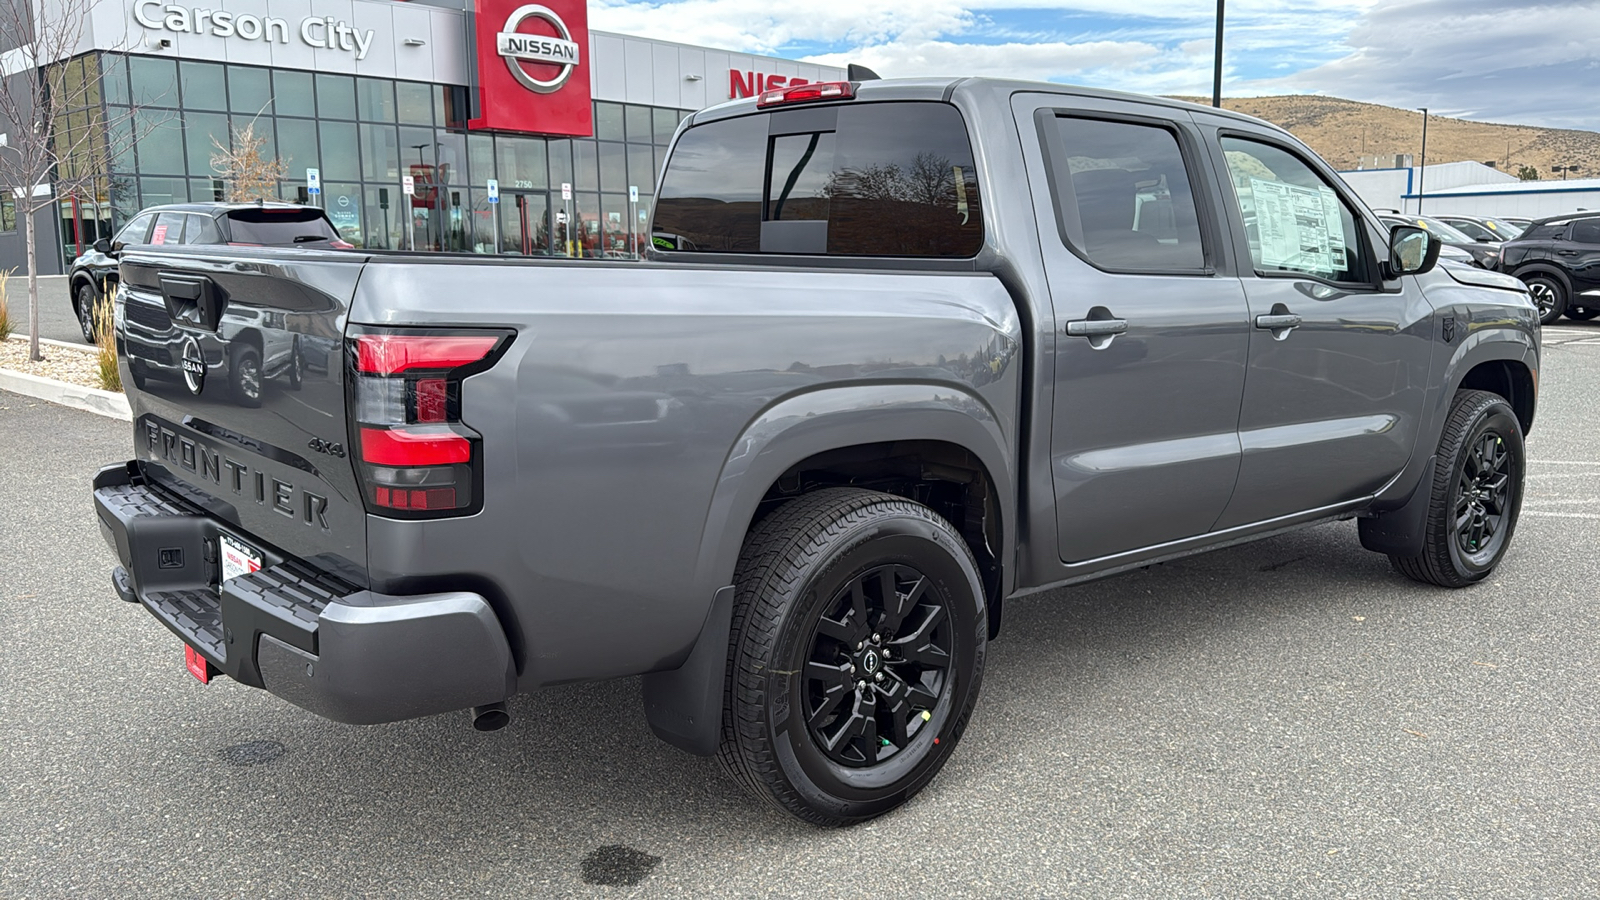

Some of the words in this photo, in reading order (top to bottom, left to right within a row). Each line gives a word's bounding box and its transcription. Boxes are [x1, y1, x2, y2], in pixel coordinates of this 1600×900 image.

[133, 0, 289, 44] Carson
[301, 16, 375, 60] City
[508, 38, 574, 59] NISSAN
[515, 180, 533, 189] 2750
[145, 418, 333, 535] FRONTIER
